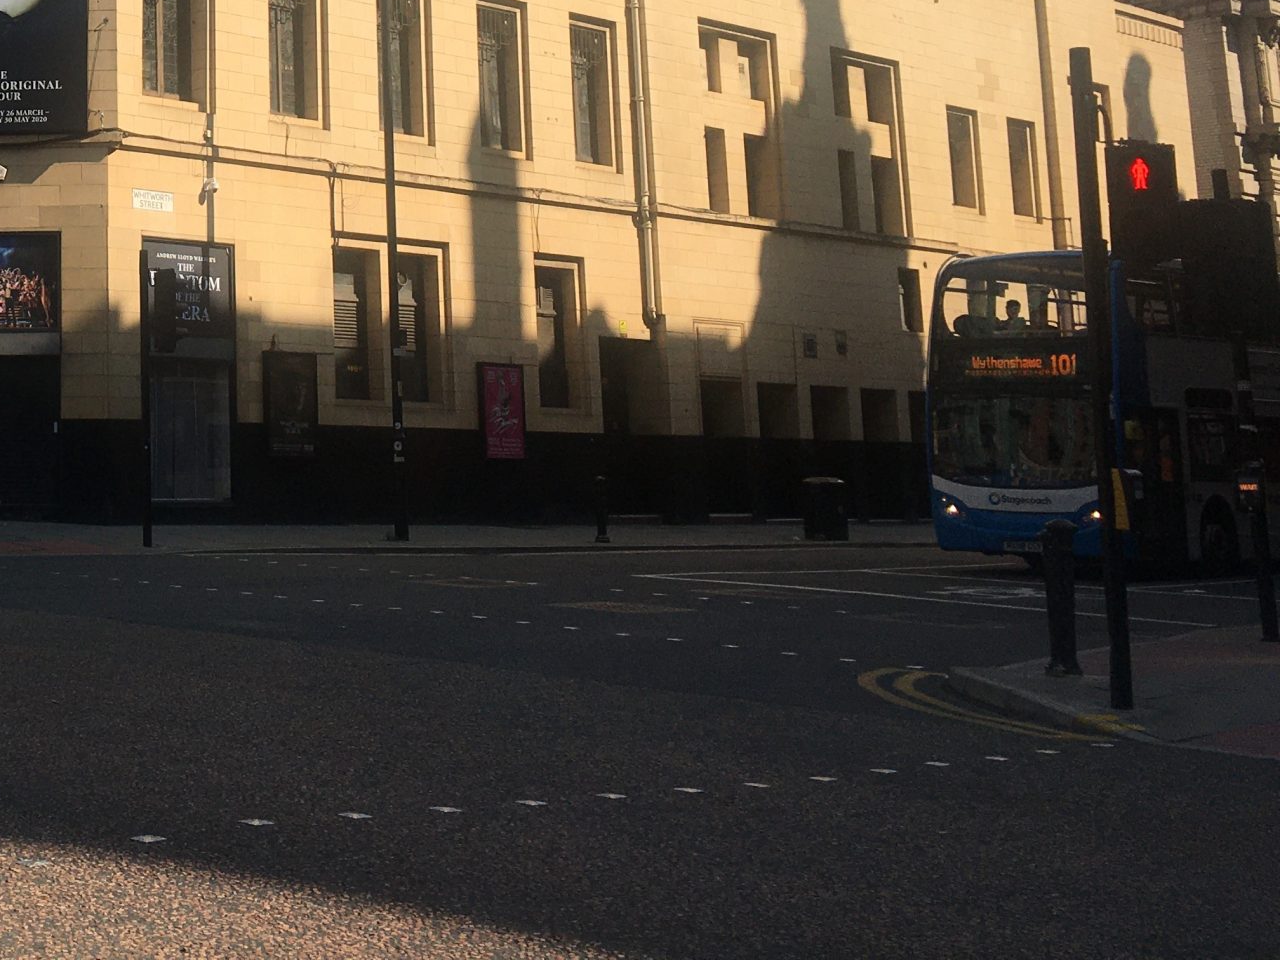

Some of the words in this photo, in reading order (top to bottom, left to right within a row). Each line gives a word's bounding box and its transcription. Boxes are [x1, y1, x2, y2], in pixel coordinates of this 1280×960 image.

[0, 80, 63, 91] ORIGINAL
[156, 252, 177, 260] ANDREW
[177, 262, 195, 272] THE
[971, 355, 1043, 369] Wythenshawe
[1049, 352, 1077, 376] 101
[1001, 494, 1052, 506] Stagecoach
